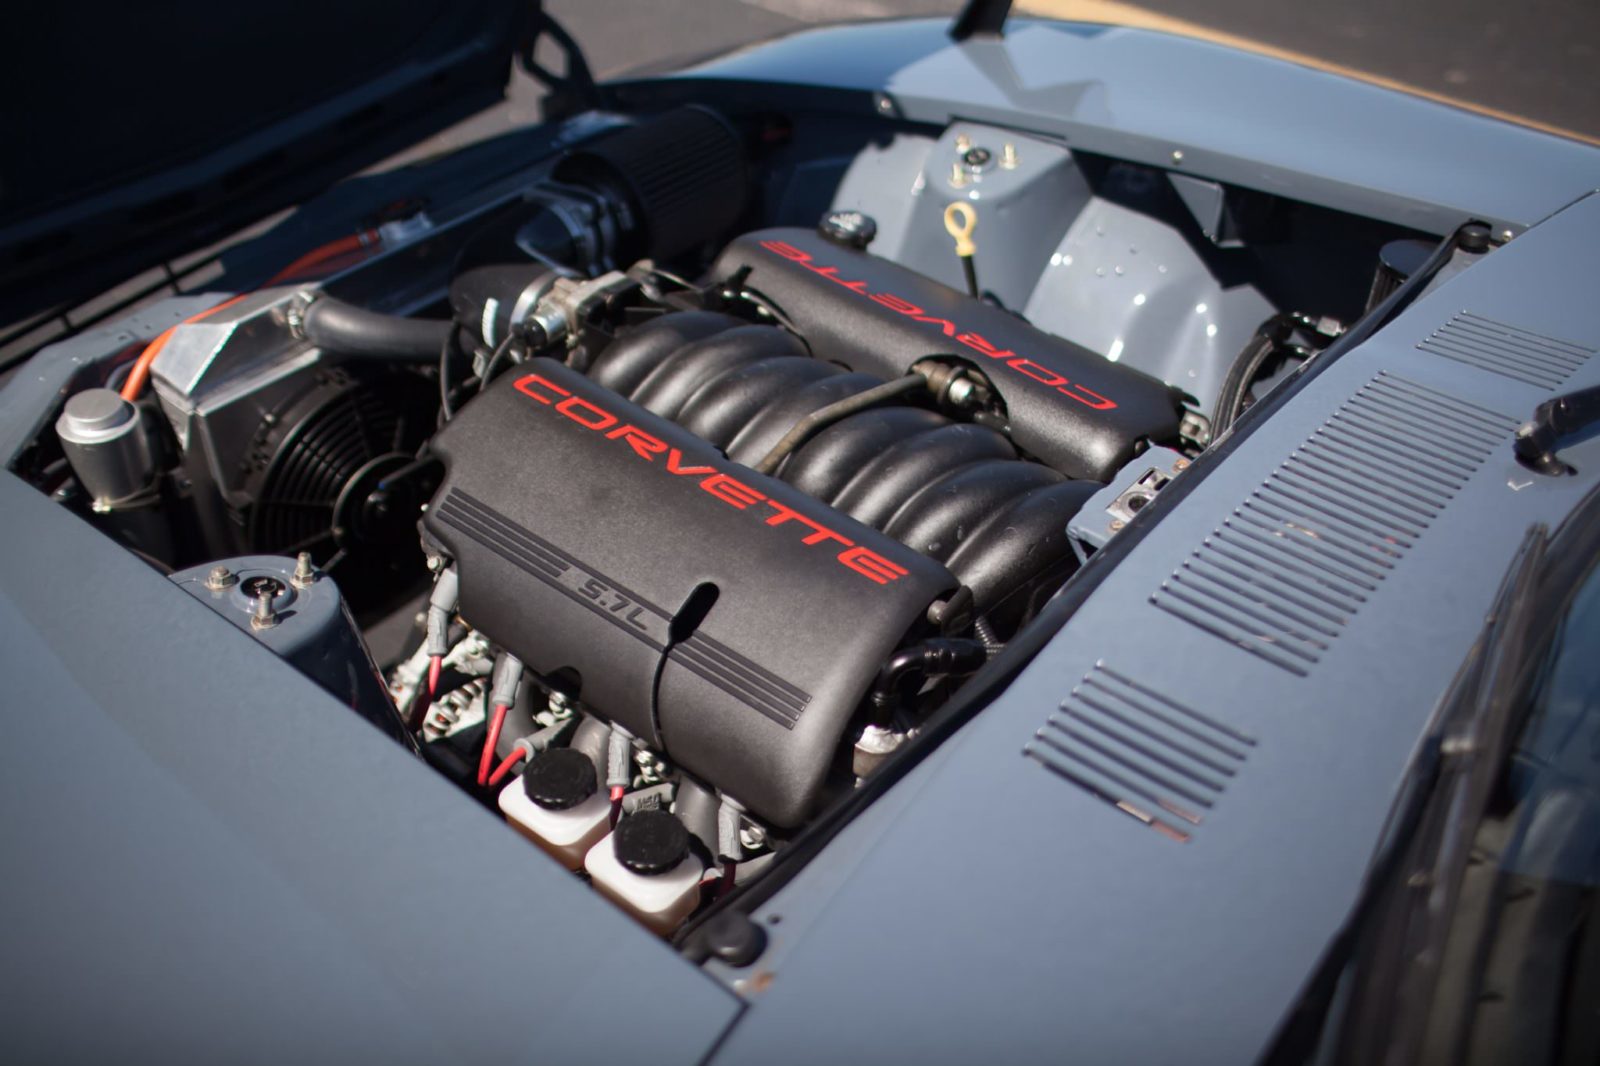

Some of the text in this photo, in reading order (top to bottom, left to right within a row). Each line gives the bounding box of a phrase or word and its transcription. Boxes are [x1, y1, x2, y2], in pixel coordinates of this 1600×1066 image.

[760, 241, 1118, 411] CORVETTE
[511, 373, 910, 586] CORVETTE
[577, 578, 647, 631] 5.7L
